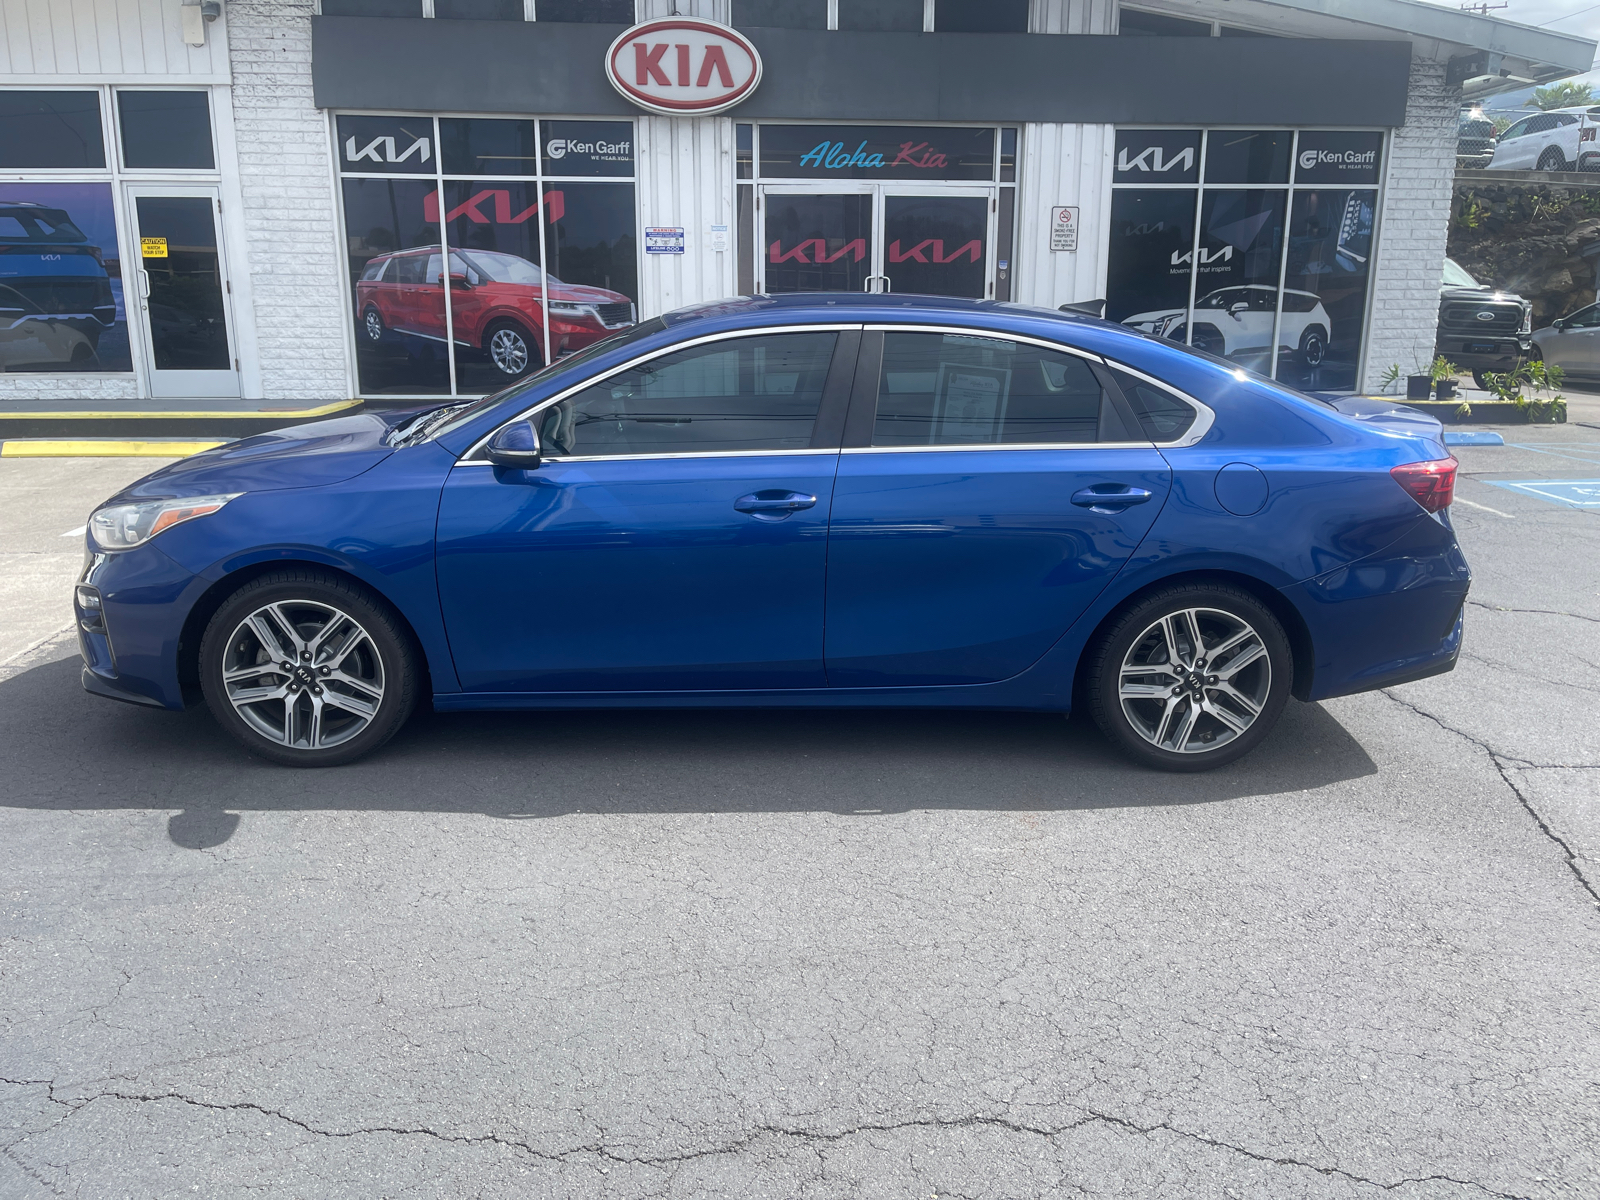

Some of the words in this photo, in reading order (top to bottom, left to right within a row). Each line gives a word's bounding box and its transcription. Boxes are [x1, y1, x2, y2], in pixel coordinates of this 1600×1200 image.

[633, 43, 735, 87] KIA
[346, 136, 430, 163] KIA
[567, 139, 594, 153] Ken
[596, 140, 630, 154] Garff
[800, 140, 885, 168] Aloha
[891, 141, 948, 168] Kia
[1318, 150, 1342, 163] Ken
[1344, 150, 1376, 163] Garff
[1118, 146, 1194, 172] KIA
[423, 188, 565, 224] KIA
[770, 239, 866, 263] KIA
[889, 239, 982, 263] KIA
[1171, 246, 1233, 265] KIA
[1211, 265, 1231, 273] inspires
[297, 668, 311, 683] KIA
[1189, 674, 1202, 689] KIA
